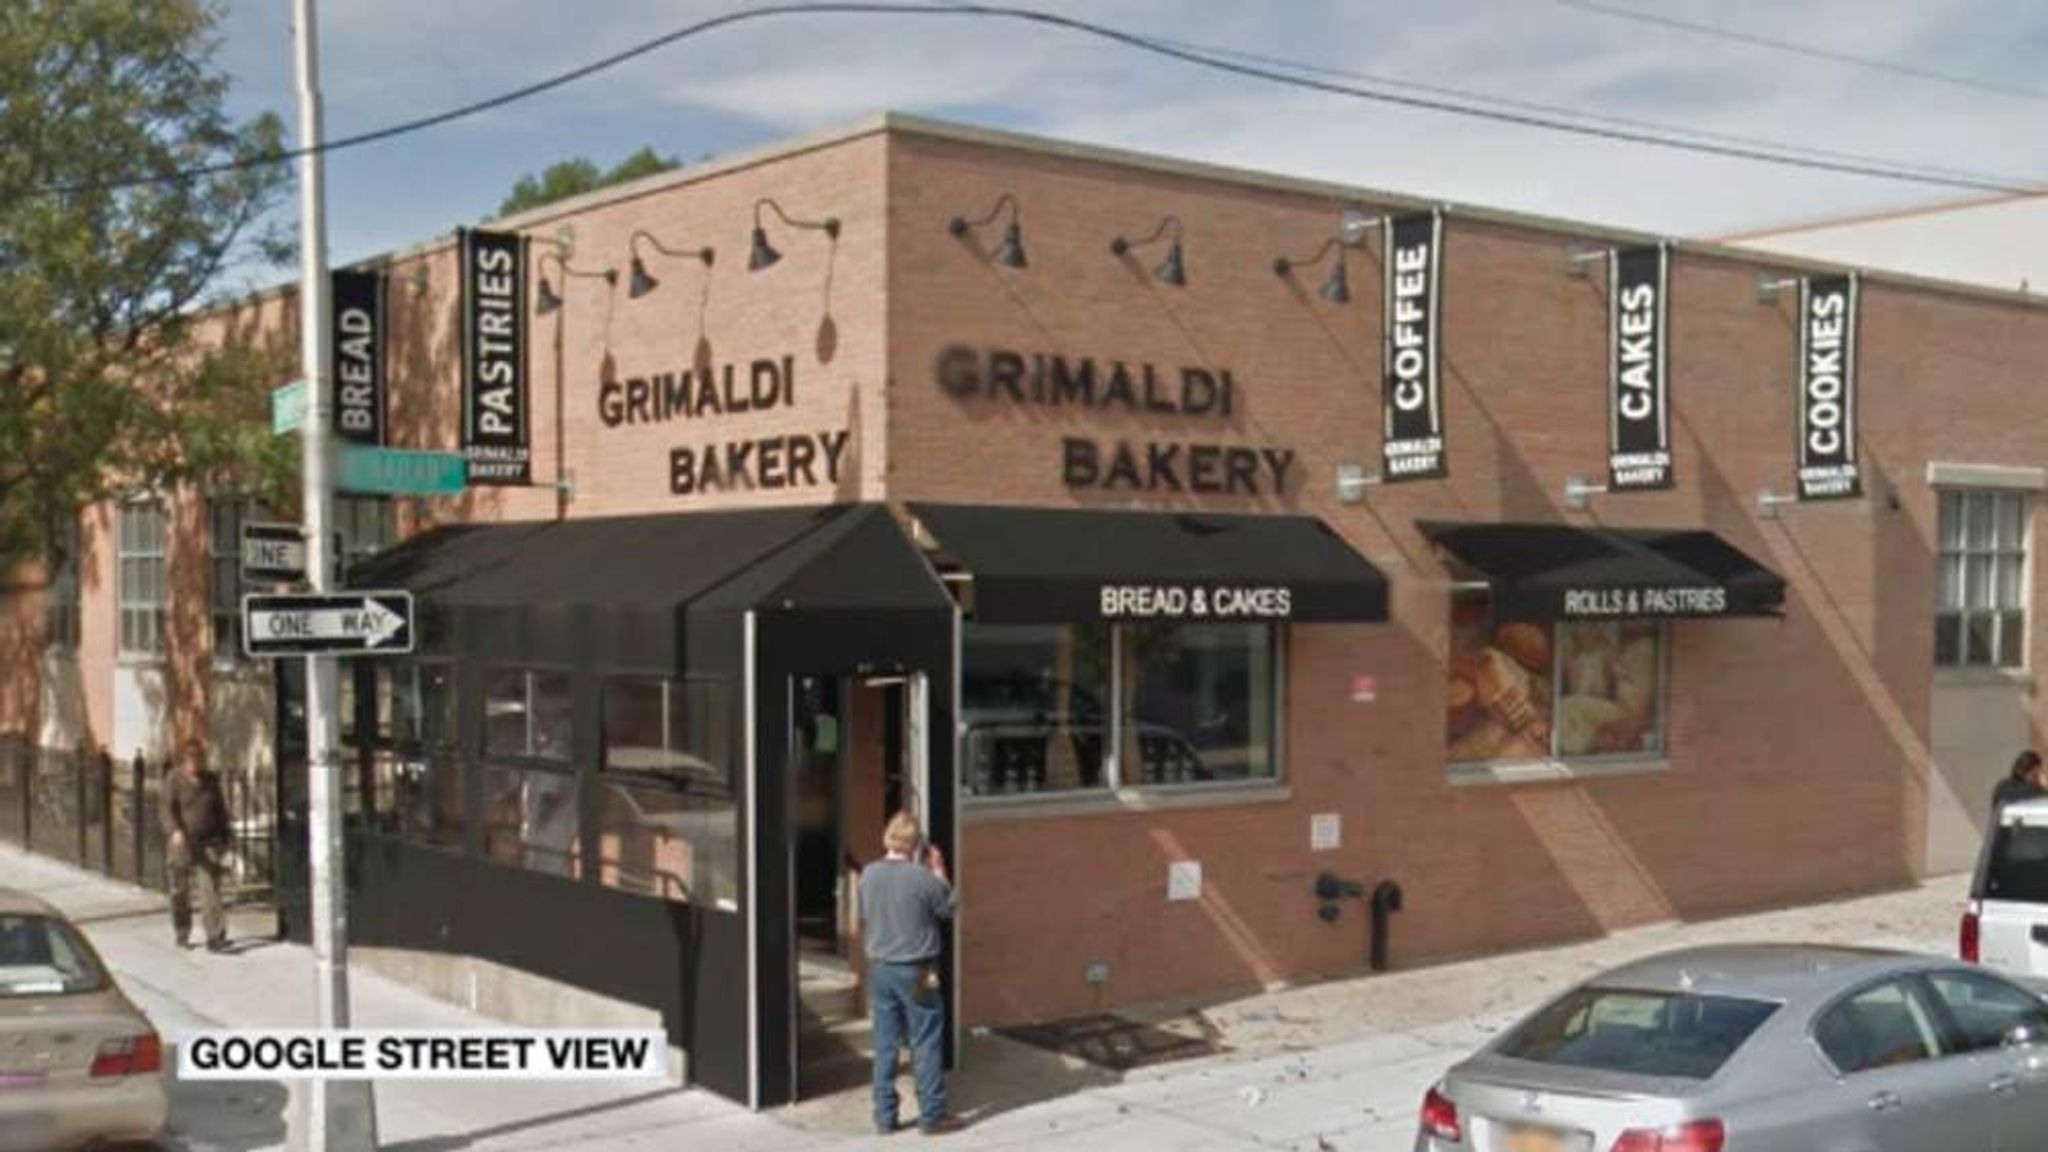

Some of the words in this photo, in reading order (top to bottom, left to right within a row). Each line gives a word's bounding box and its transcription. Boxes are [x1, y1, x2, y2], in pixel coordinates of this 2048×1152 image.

[479, 247, 513, 435] PASTRIES
[1394, 244, 1427, 411] COFFEE
[1620, 282, 1654, 419] CAKES
[340, 308, 374, 430] BREAD
[598, 354, 794, 427] GRIMALDI
[935, 344, 1233, 418] GRIMALDI
[1809, 291, 1844, 455] COOKIES
[670, 429, 850, 495] BAKERY
[1061, 436, 1295, 494] BAKERY
[268, 613, 313, 636] ONE
[340, 611, 388, 632] WAY
[1101, 585, 1187, 615] BREAD
[1191, 588, 1208, 615] &
[1212, 587, 1291, 616] CAKES
[1564, 588, 1623, 614] ROLLS
[1627, 589, 1640, 613] &
[1643, 586, 1727, 613] PASTRIES
